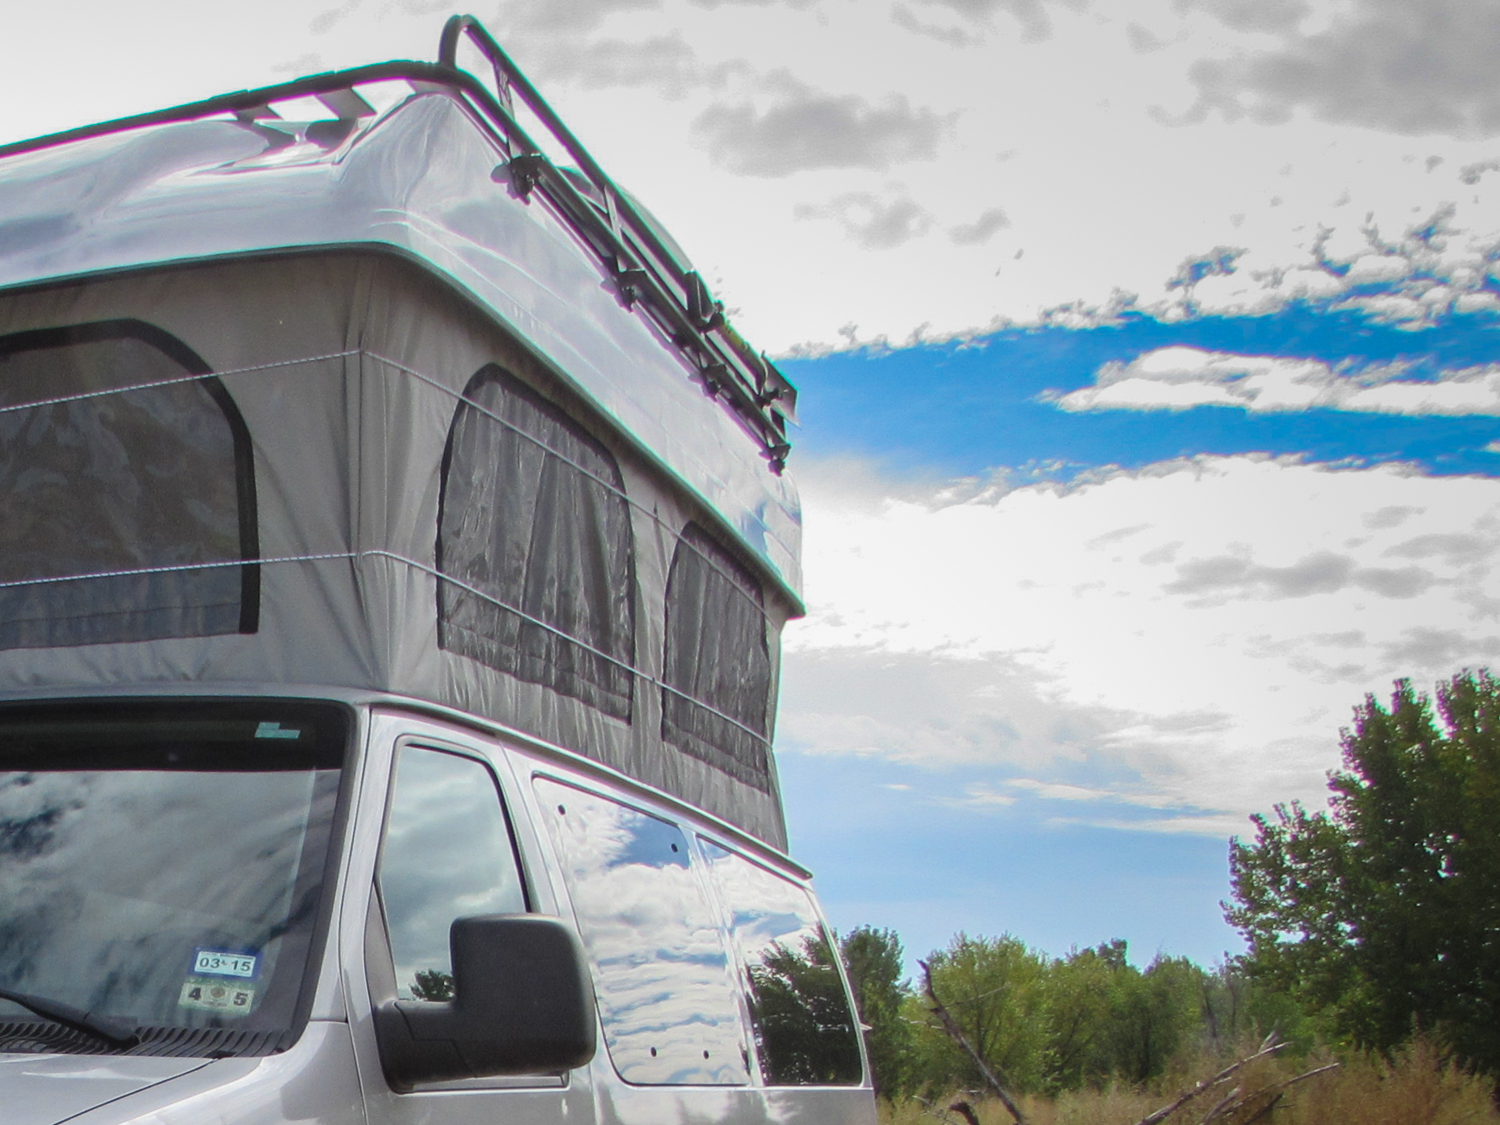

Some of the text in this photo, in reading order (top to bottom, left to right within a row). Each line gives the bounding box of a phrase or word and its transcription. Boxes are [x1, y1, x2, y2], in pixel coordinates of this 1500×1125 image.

[200, 957, 252, 972] 03 15
[188, 987, 201, 1001] 4
[233, 992, 248, 1006] 5
